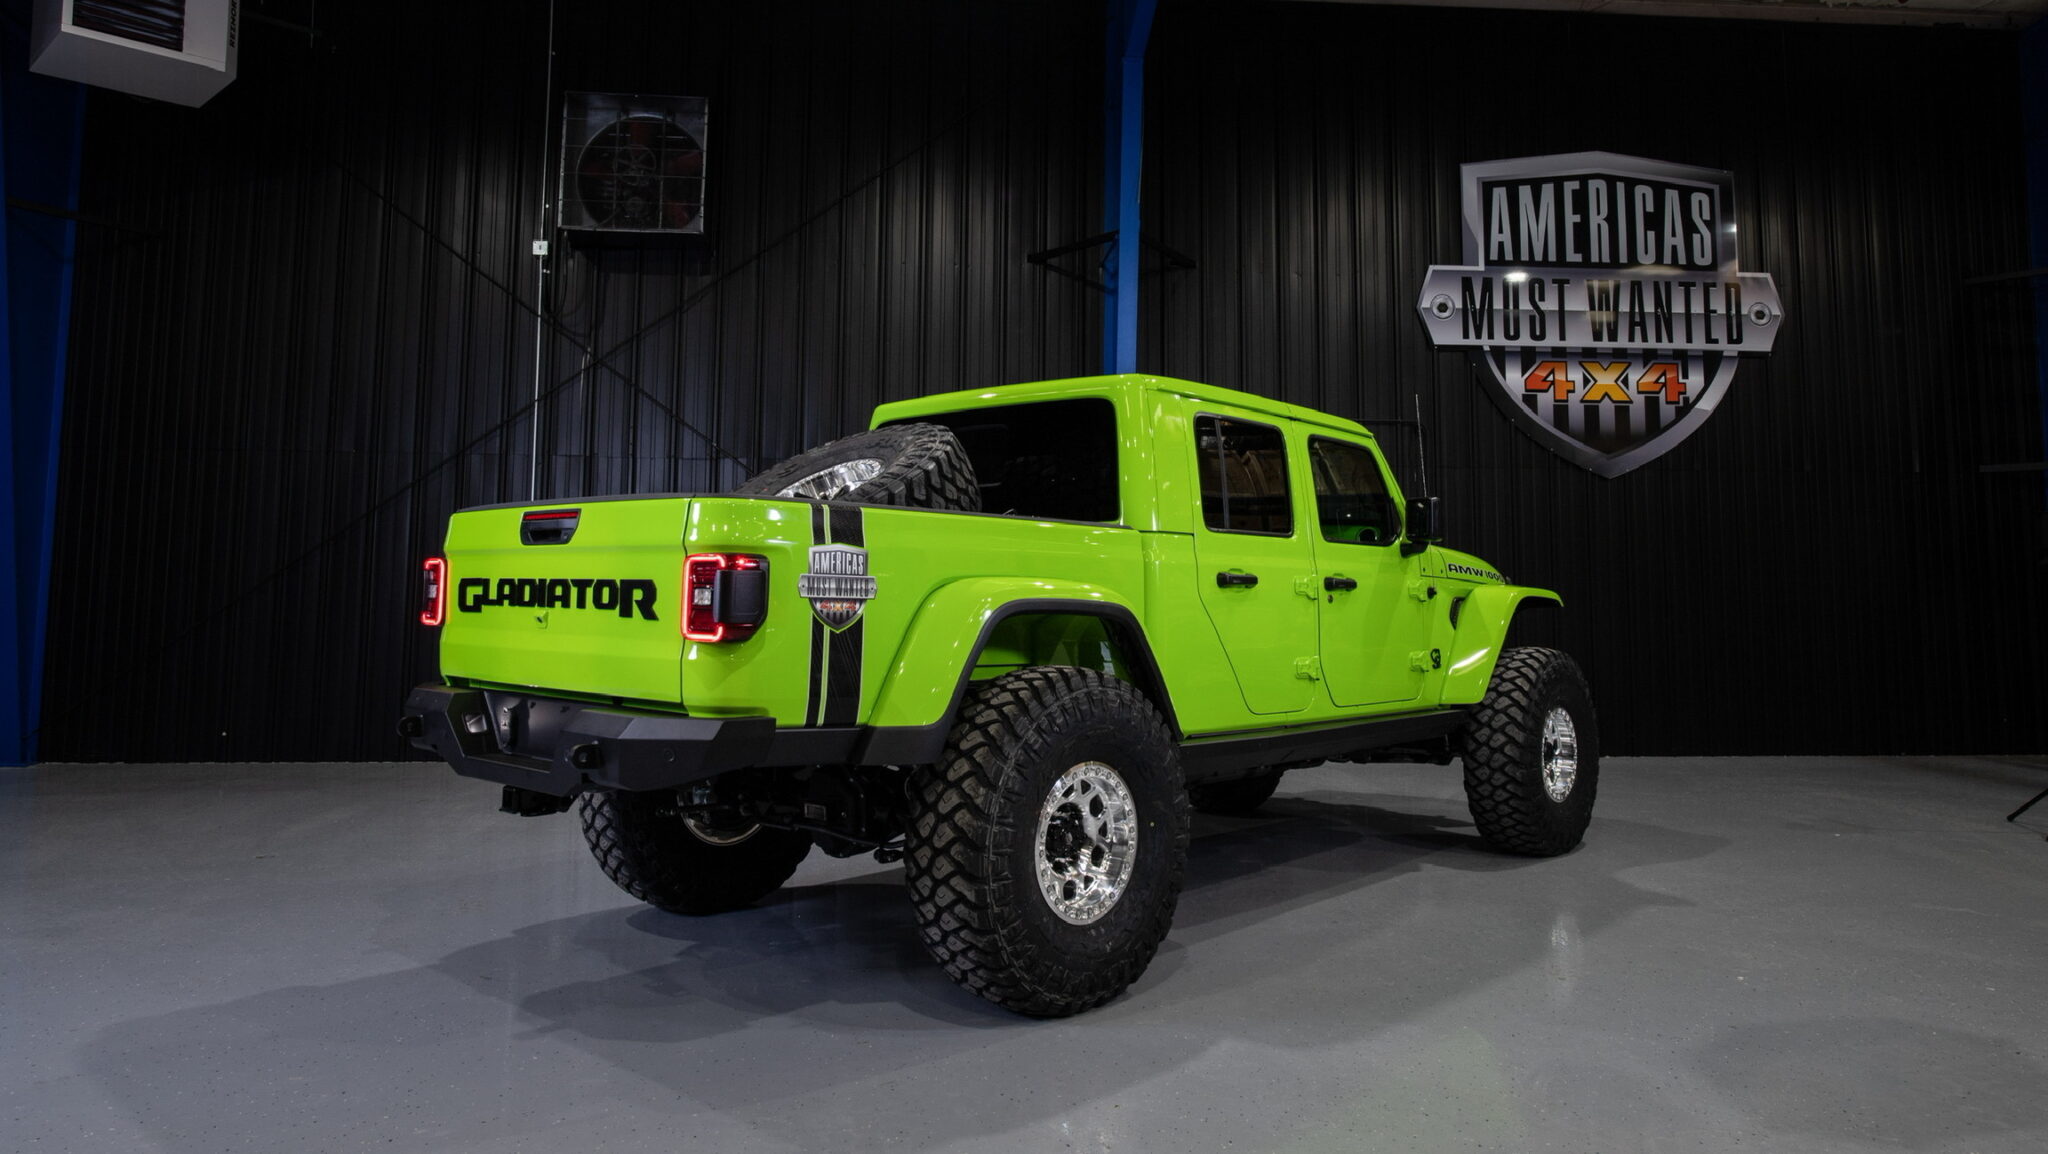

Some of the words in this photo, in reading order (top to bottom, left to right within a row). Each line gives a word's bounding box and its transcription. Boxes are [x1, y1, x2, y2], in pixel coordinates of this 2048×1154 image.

[1489, 179, 1713, 266] AMERICAS
[1461, 276, 1570, 341] MOST
[1586, 279, 1744, 345] WANTED
[1524, 361, 1687, 404] 4X4
[814, 551, 863, 575] AMERICAS
[1448, 563, 1483, 577] AMW
[458, 577, 659, 621] GLADIATOR
[807, 576, 831, 596] MOST
[835, 578, 869, 597] WANTED
